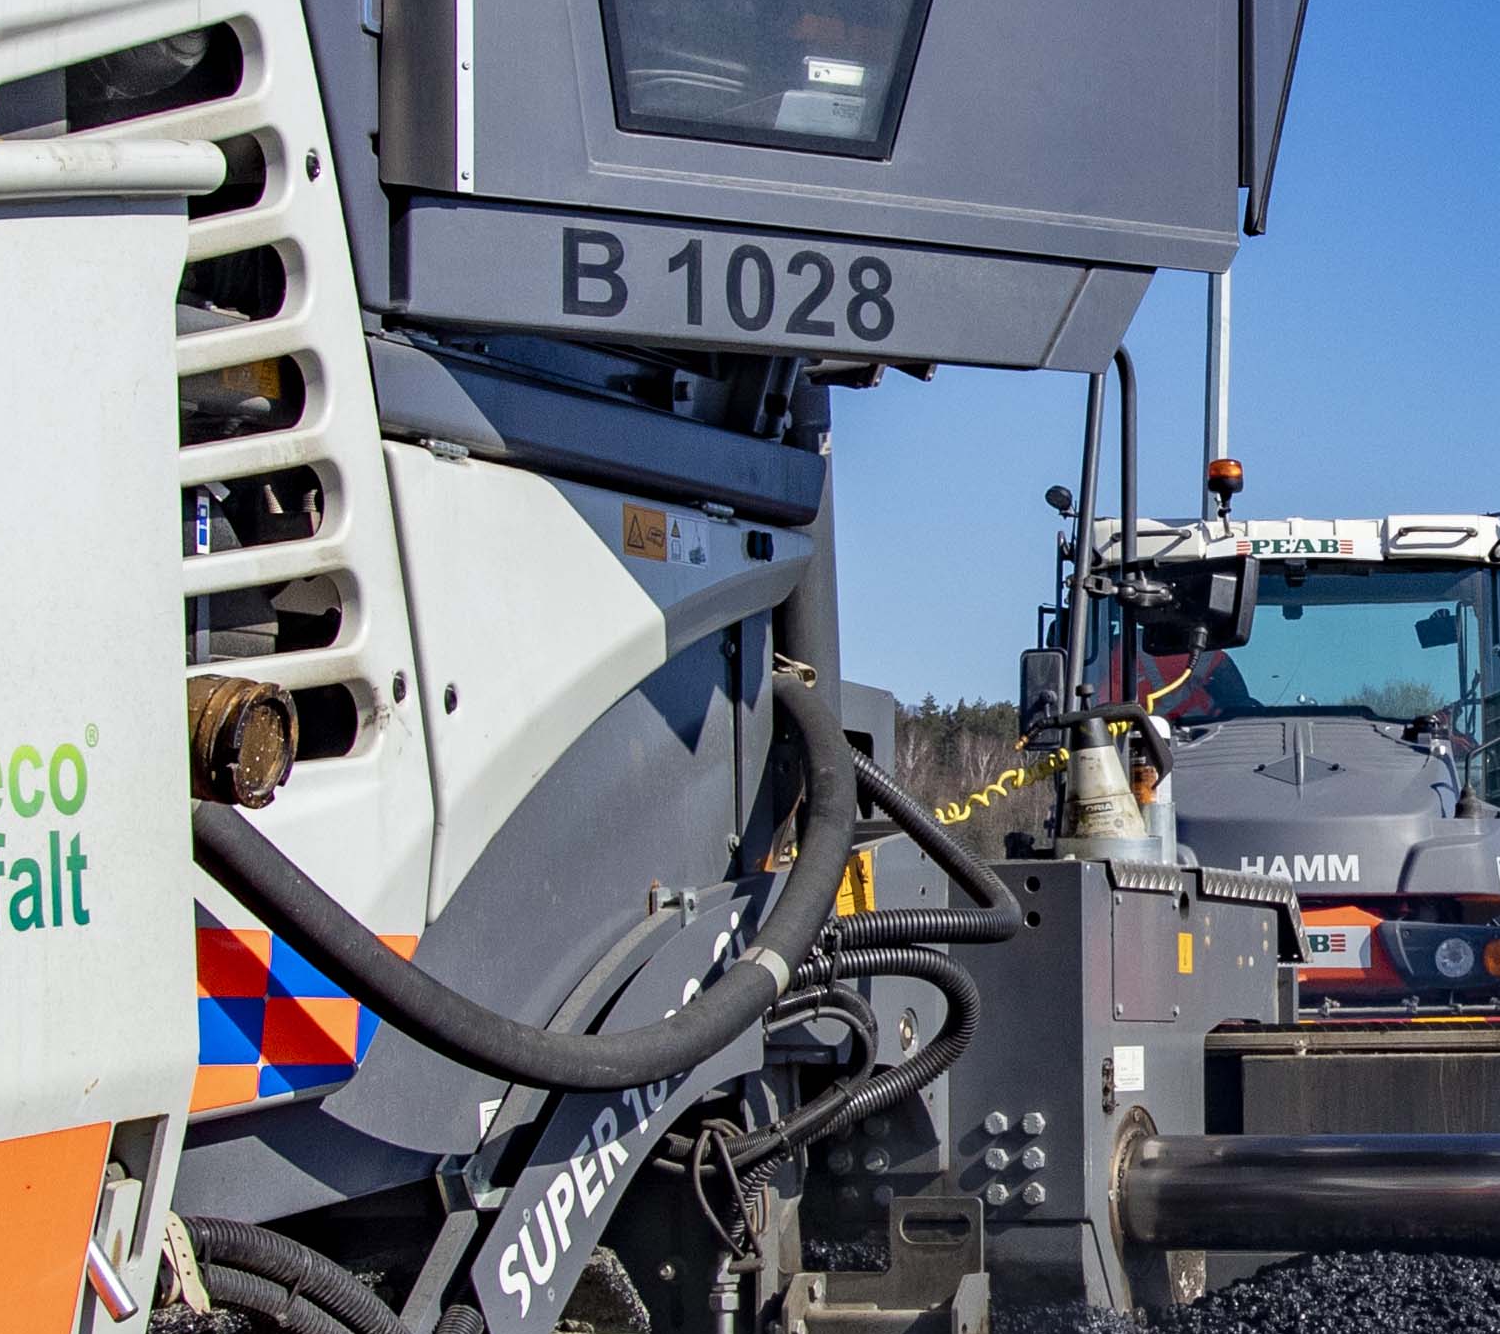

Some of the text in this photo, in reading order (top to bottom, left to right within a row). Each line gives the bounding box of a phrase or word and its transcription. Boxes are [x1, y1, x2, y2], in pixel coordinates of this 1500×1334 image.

[562, 226, 895, 342] B 1028
[1250, 539, 1339, 554] PEAB
[1241, 854, 1360, 882] HAMM
[500, 1105, 630, 1319] SUPER
